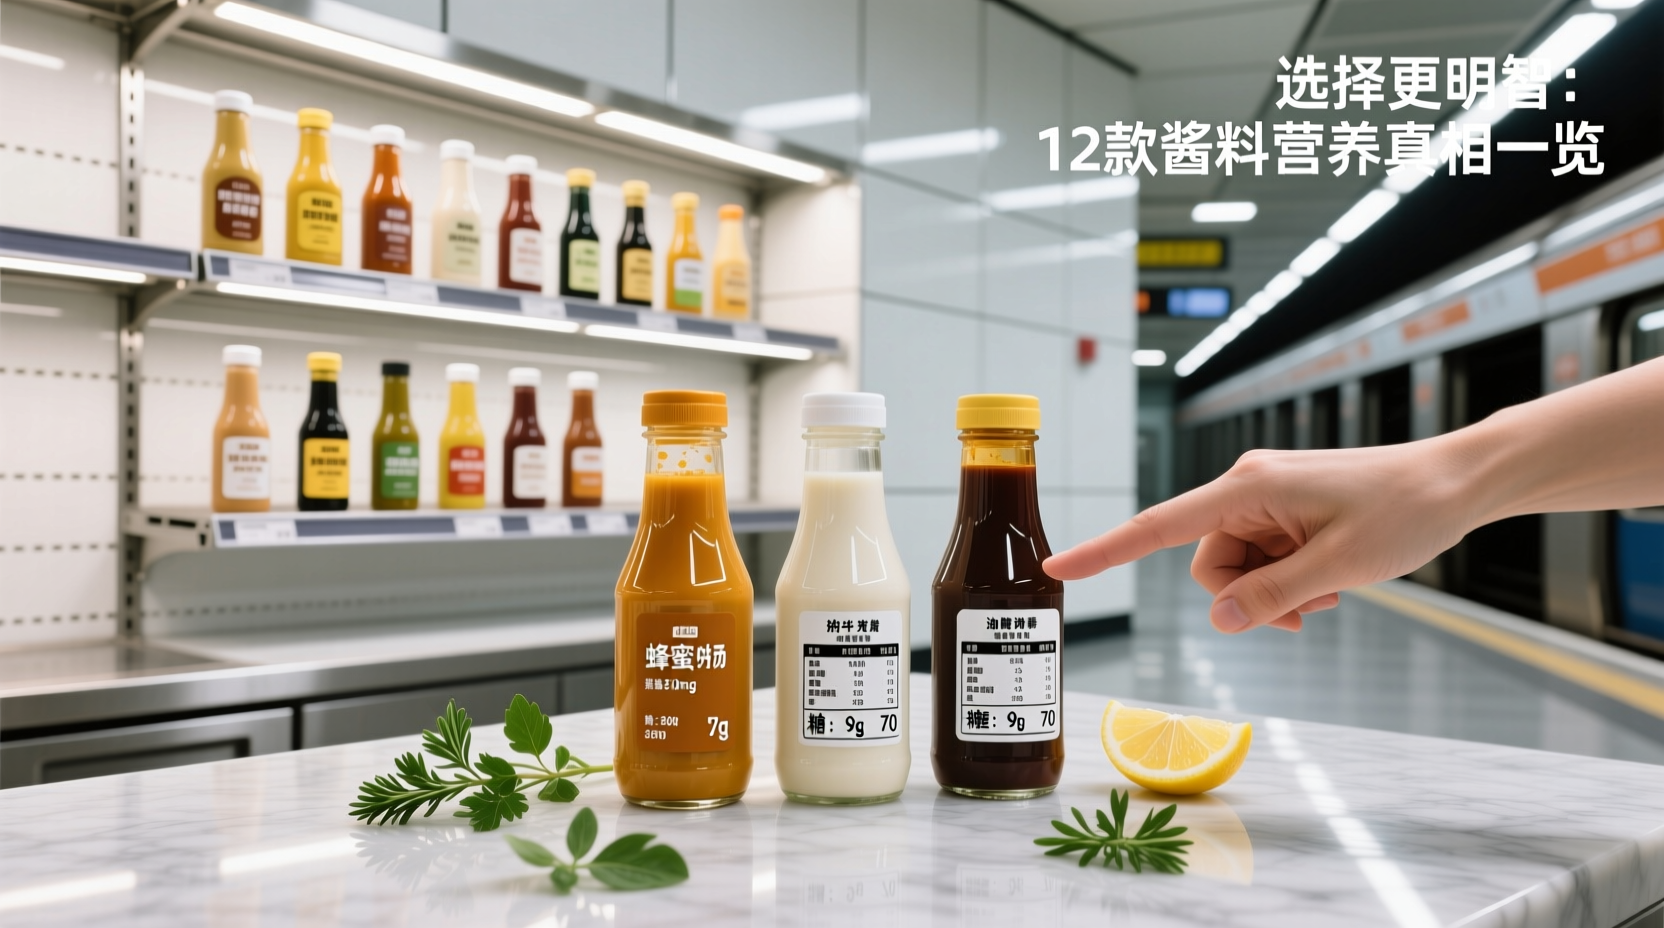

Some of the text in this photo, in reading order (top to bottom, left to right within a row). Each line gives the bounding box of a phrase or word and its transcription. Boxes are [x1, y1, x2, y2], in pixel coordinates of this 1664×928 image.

[707, 716, 729, 741] 7g
[845, 715, 865, 738] 9g
[880, 713, 898, 732] 70
[1040, 709, 1056, 727] 70
